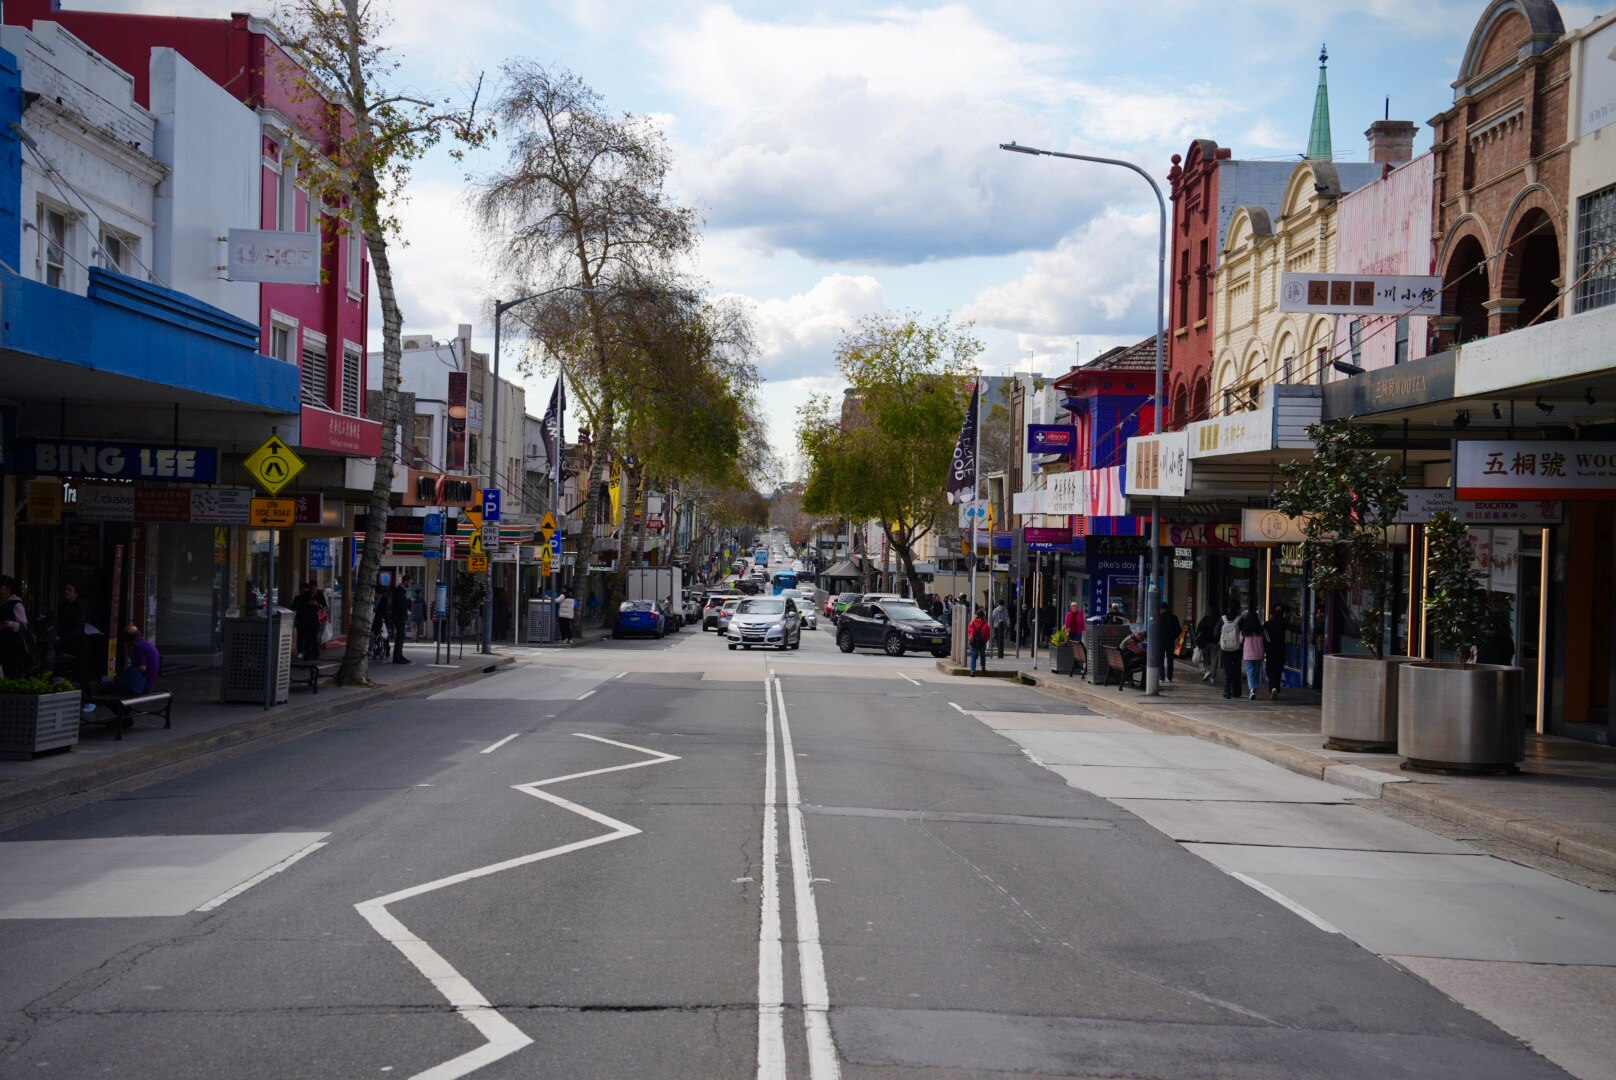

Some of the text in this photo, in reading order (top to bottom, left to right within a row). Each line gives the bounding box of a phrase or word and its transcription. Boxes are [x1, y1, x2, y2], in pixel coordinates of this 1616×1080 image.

[1394, 375, 1426, 396] WOOTEA
[35, 444, 198, 478] BING LEE
[1482, 451, 1566, 477] 五桐號
[267, 500, 278, 508] ON
[1475, 502, 1519, 510] EDUCATION
[485, 502, 497, 518] P
[483, 534, 497, 542] WAY
[472, 558, 486, 567] 25
[1098, 561, 1120, 570] pike's
[1121, 561, 1137, 571] day
